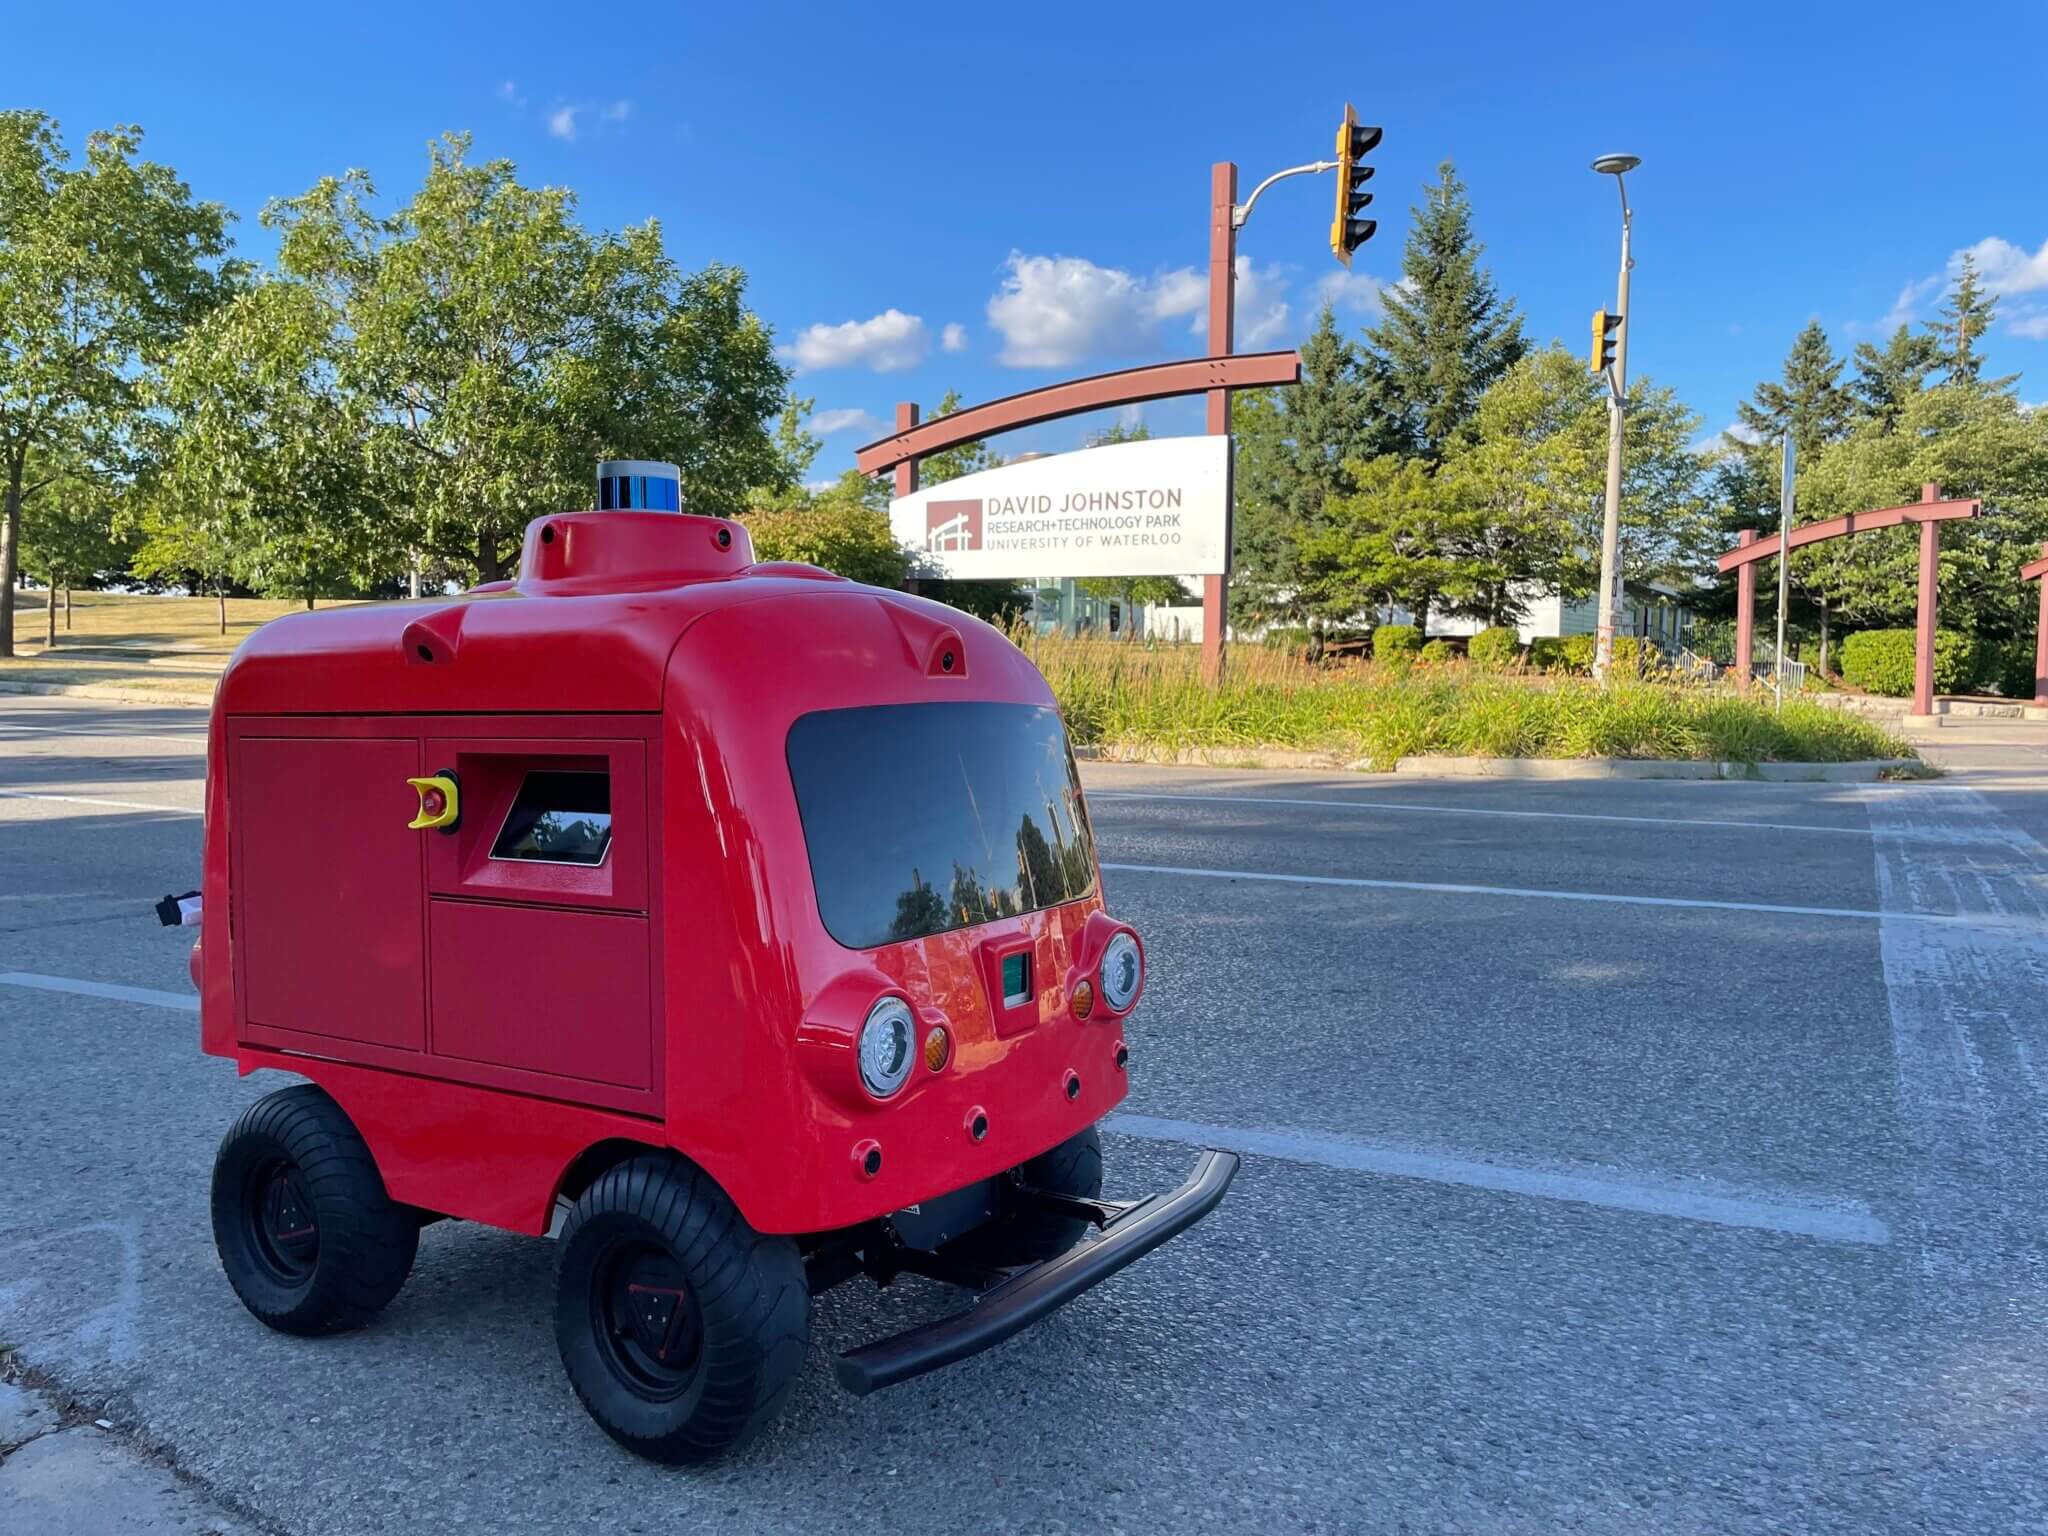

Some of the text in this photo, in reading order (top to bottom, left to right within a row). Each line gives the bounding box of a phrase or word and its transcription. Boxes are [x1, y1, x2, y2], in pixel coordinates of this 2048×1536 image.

[988, 488, 1182, 516] DAVID JOHNSTON
[987, 513, 1182, 534] RESEARCH+TECHNOLOGY PARK
[987, 532, 1182, 551] UNIVERSITY OF WATERLOO
